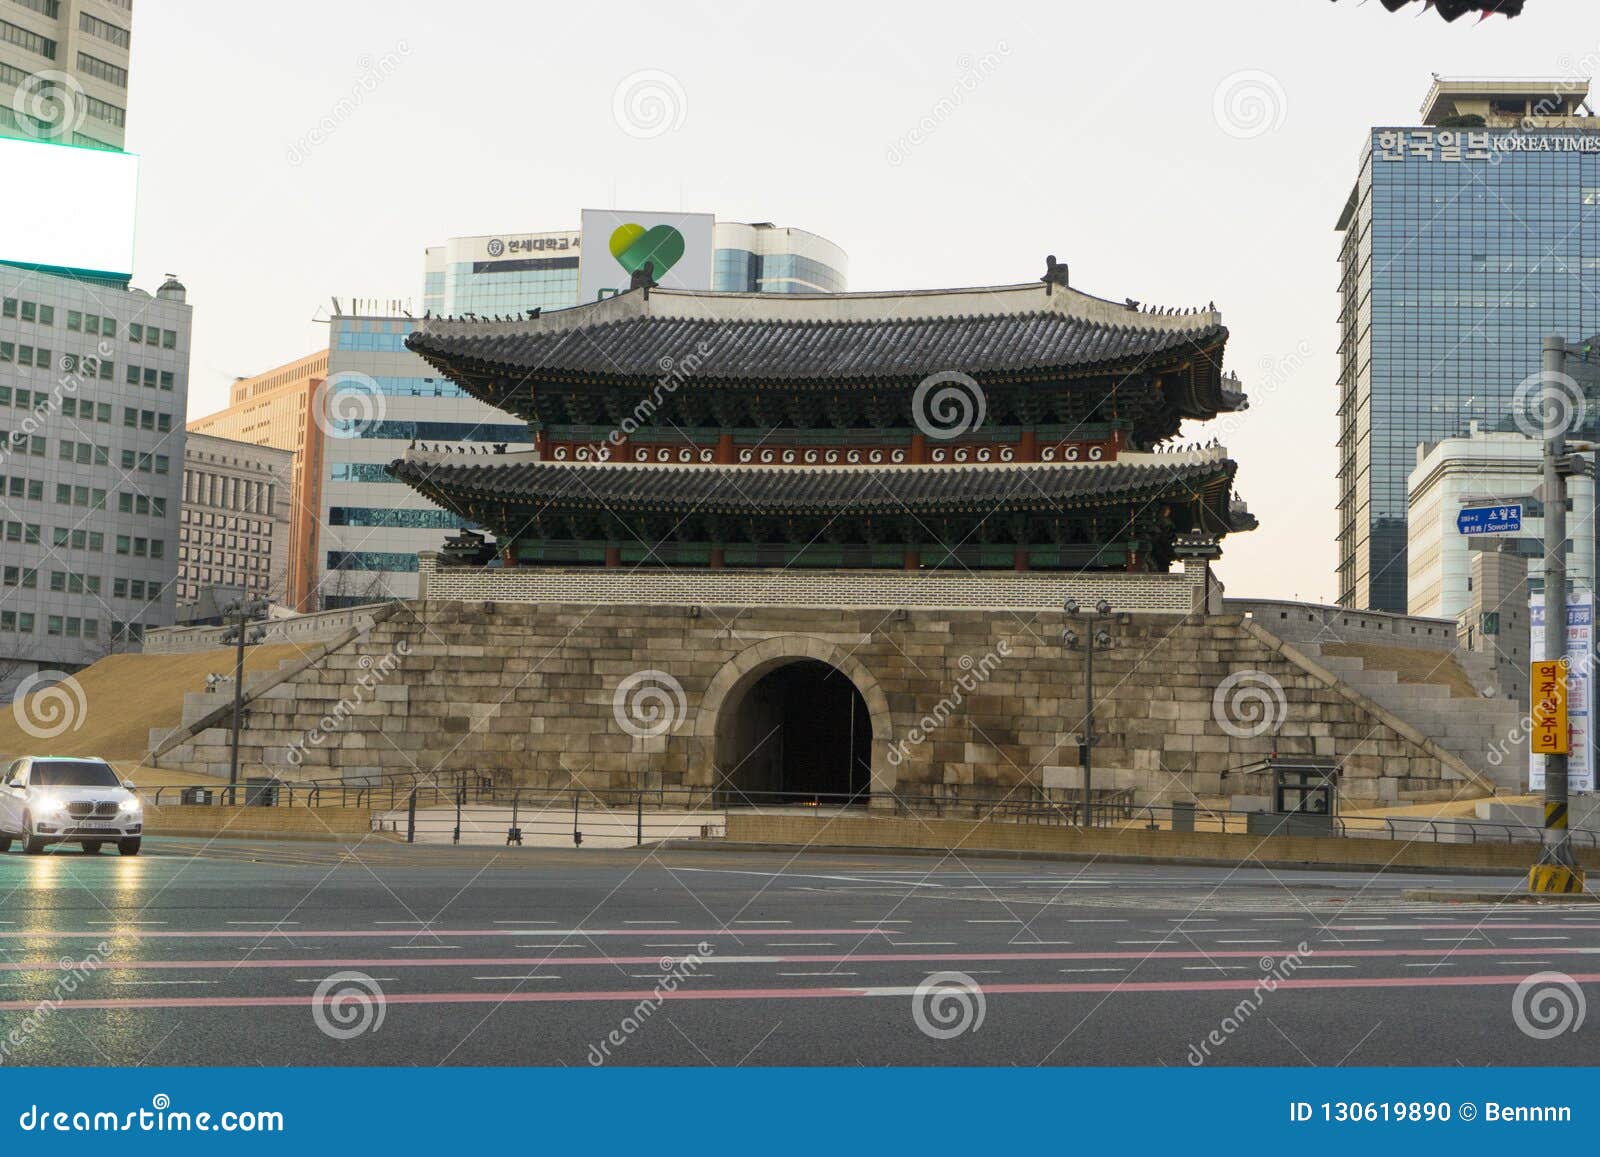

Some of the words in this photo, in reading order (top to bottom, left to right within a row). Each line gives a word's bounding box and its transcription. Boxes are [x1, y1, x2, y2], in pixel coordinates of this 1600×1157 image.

[1379, 130, 1491, 162] 한국일보
[508, 238, 569, 253] 연세대학교
[1488, 508, 1518, 521] 소월로
